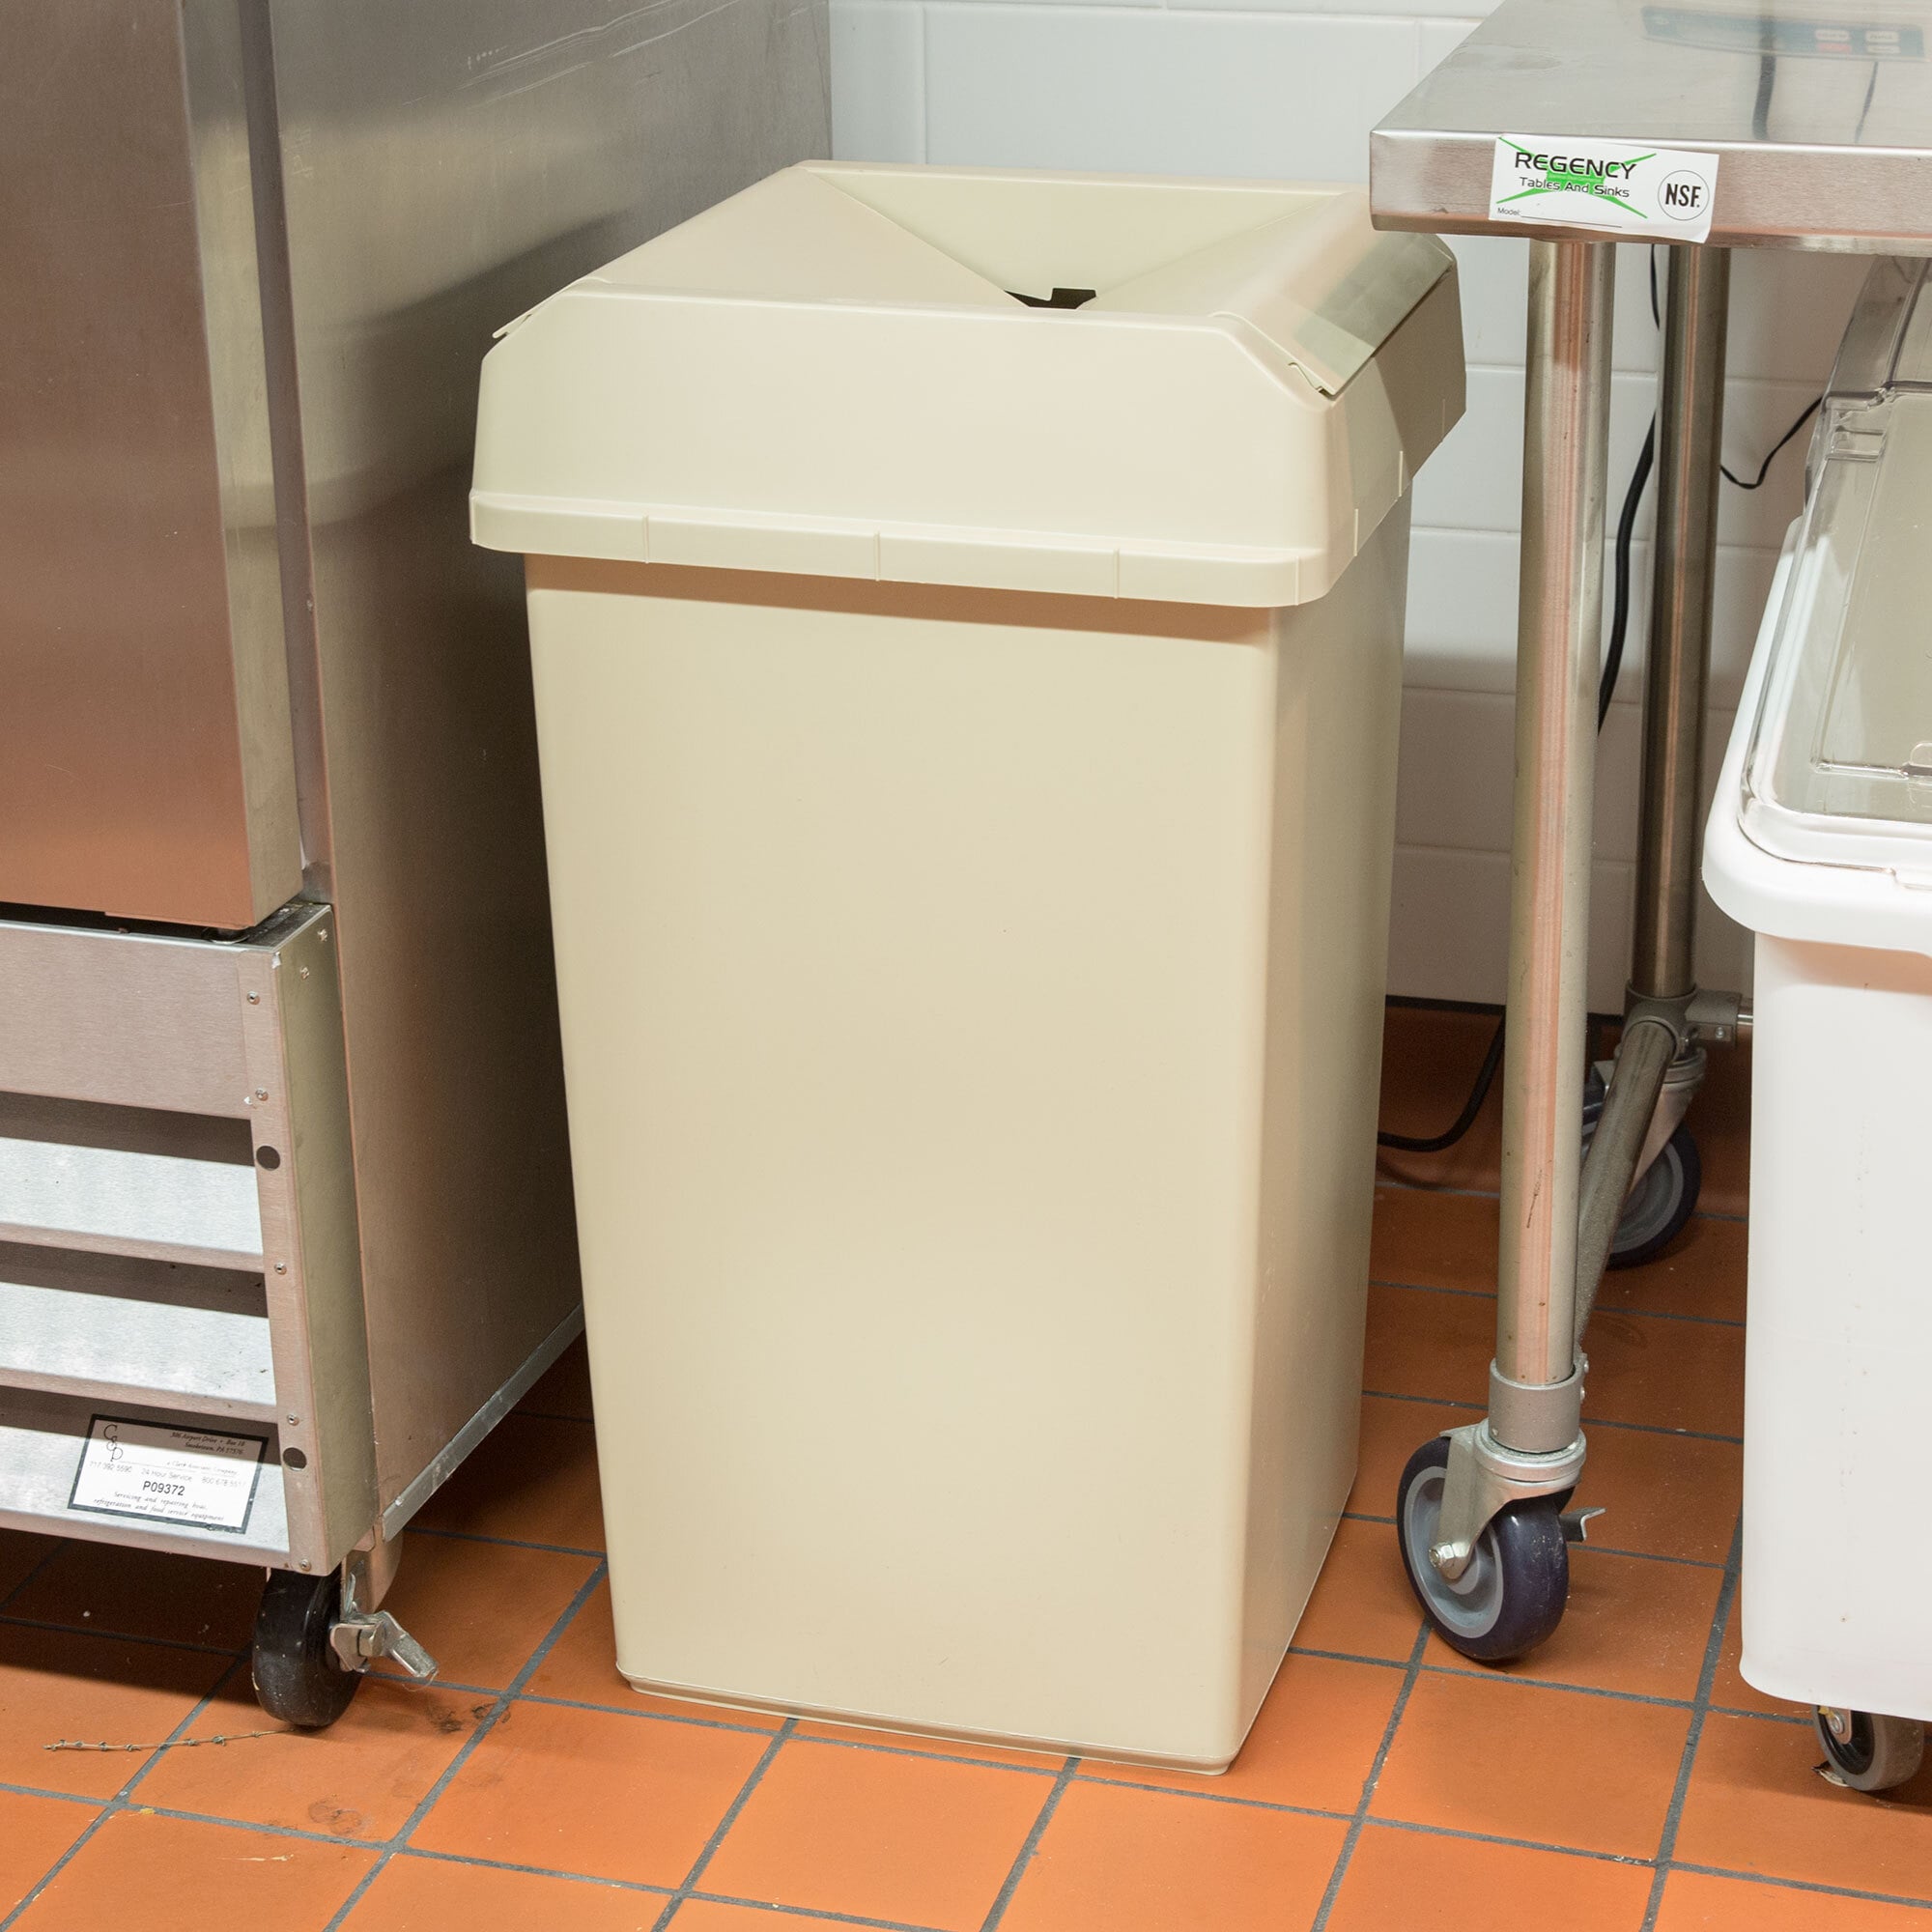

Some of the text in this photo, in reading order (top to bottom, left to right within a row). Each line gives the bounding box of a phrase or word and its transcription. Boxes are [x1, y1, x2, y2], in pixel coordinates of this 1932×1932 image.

[1515, 152, 1636, 180] REGENCY
[1520, 177, 1630, 198] Tables And Sinks
[168, 1470, 193, 1482] Service
[142, 1480, 185, 1496] P09372
[93, 1498, 132, 1511] refrigeration
[134, 1502, 147, 1511] and
[150, 1505, 165, 1515] food
[114, 1491, 142, 1502] Servicing
[160, 1498, 189, 1510] repairing
